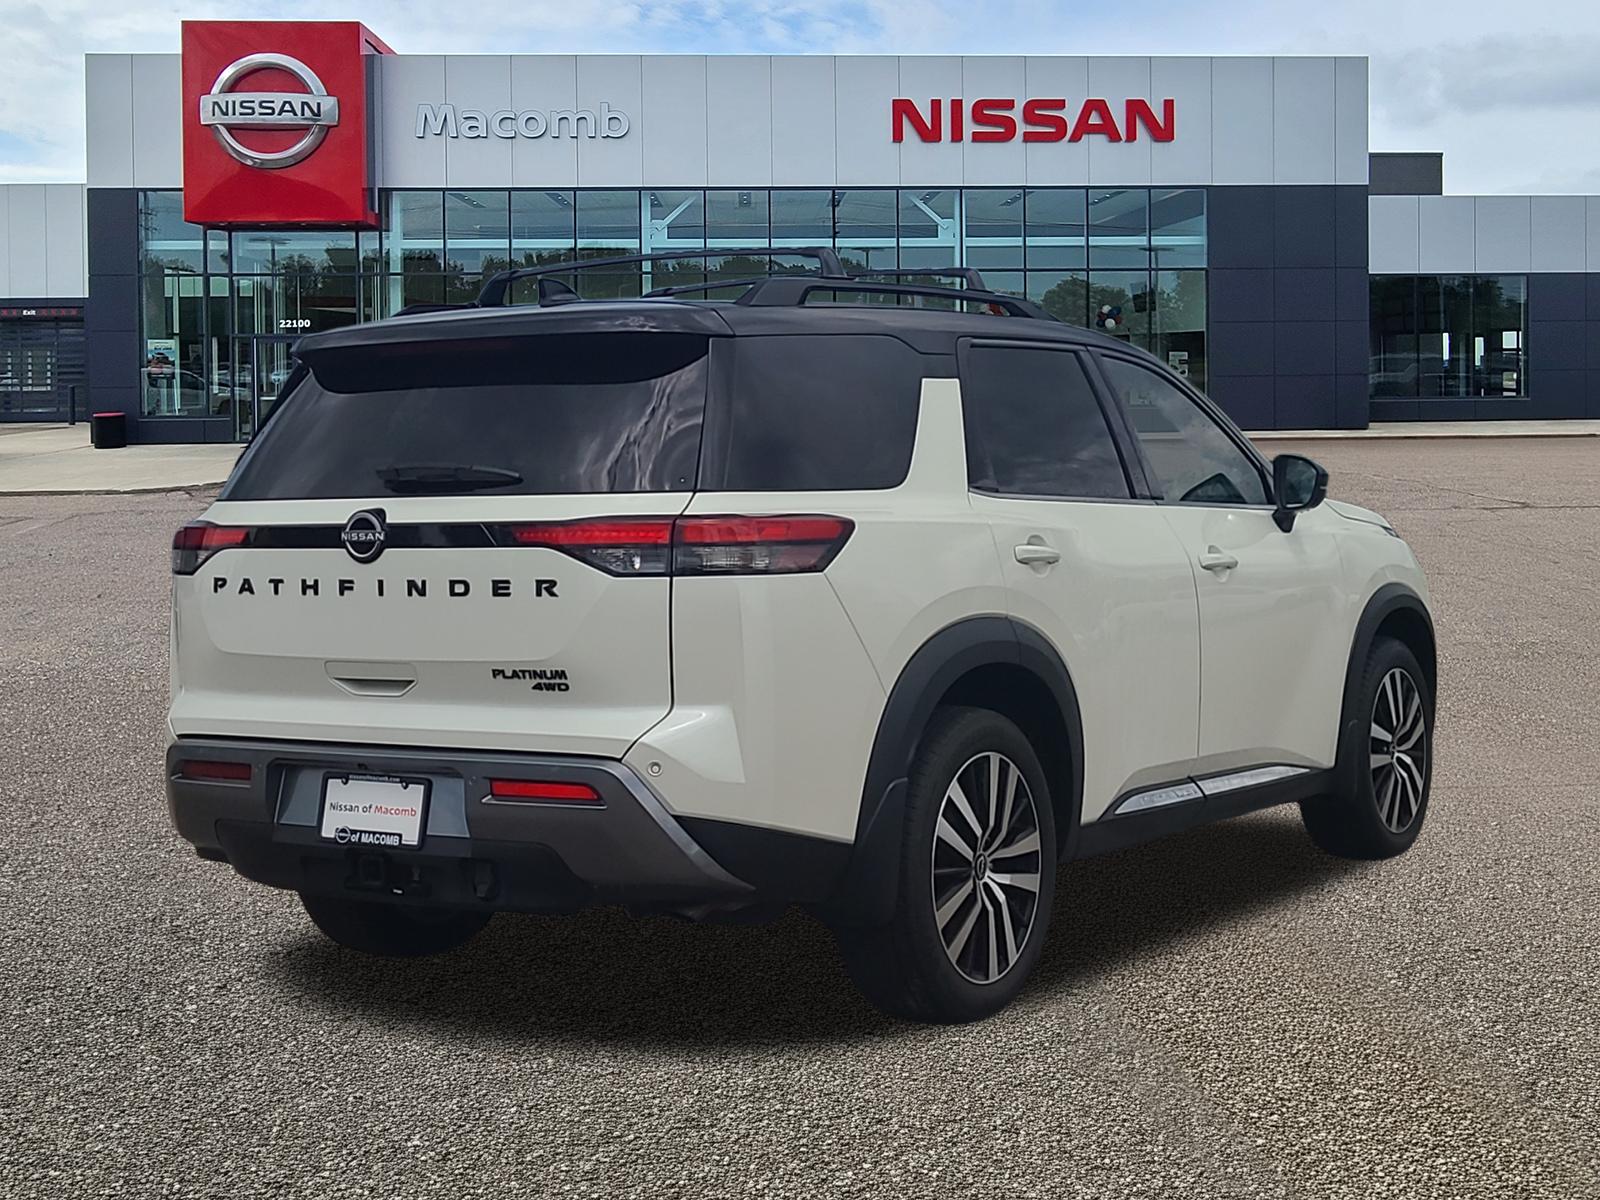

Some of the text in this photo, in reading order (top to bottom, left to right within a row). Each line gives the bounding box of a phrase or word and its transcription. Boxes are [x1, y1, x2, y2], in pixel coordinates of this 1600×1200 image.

[211, 99, 322, 118] NISSAN
[414, 102, 630, 139] Macomb
[892, 98, 1175, 143] NISSAN
[279, 319, 311, 328] 22100
[341, 531, 385, 541] NISSAN
[213, 576, 560, 598] PATHFINDER
[491, 669, 569, 680] PLATINUM
[531, 682, 570, 692] 4WD
[329, 802, 417, 817] Nissan of Macomb
[350, 832, 360, 843] of
[360, 832, 400, 846] MACOMB
